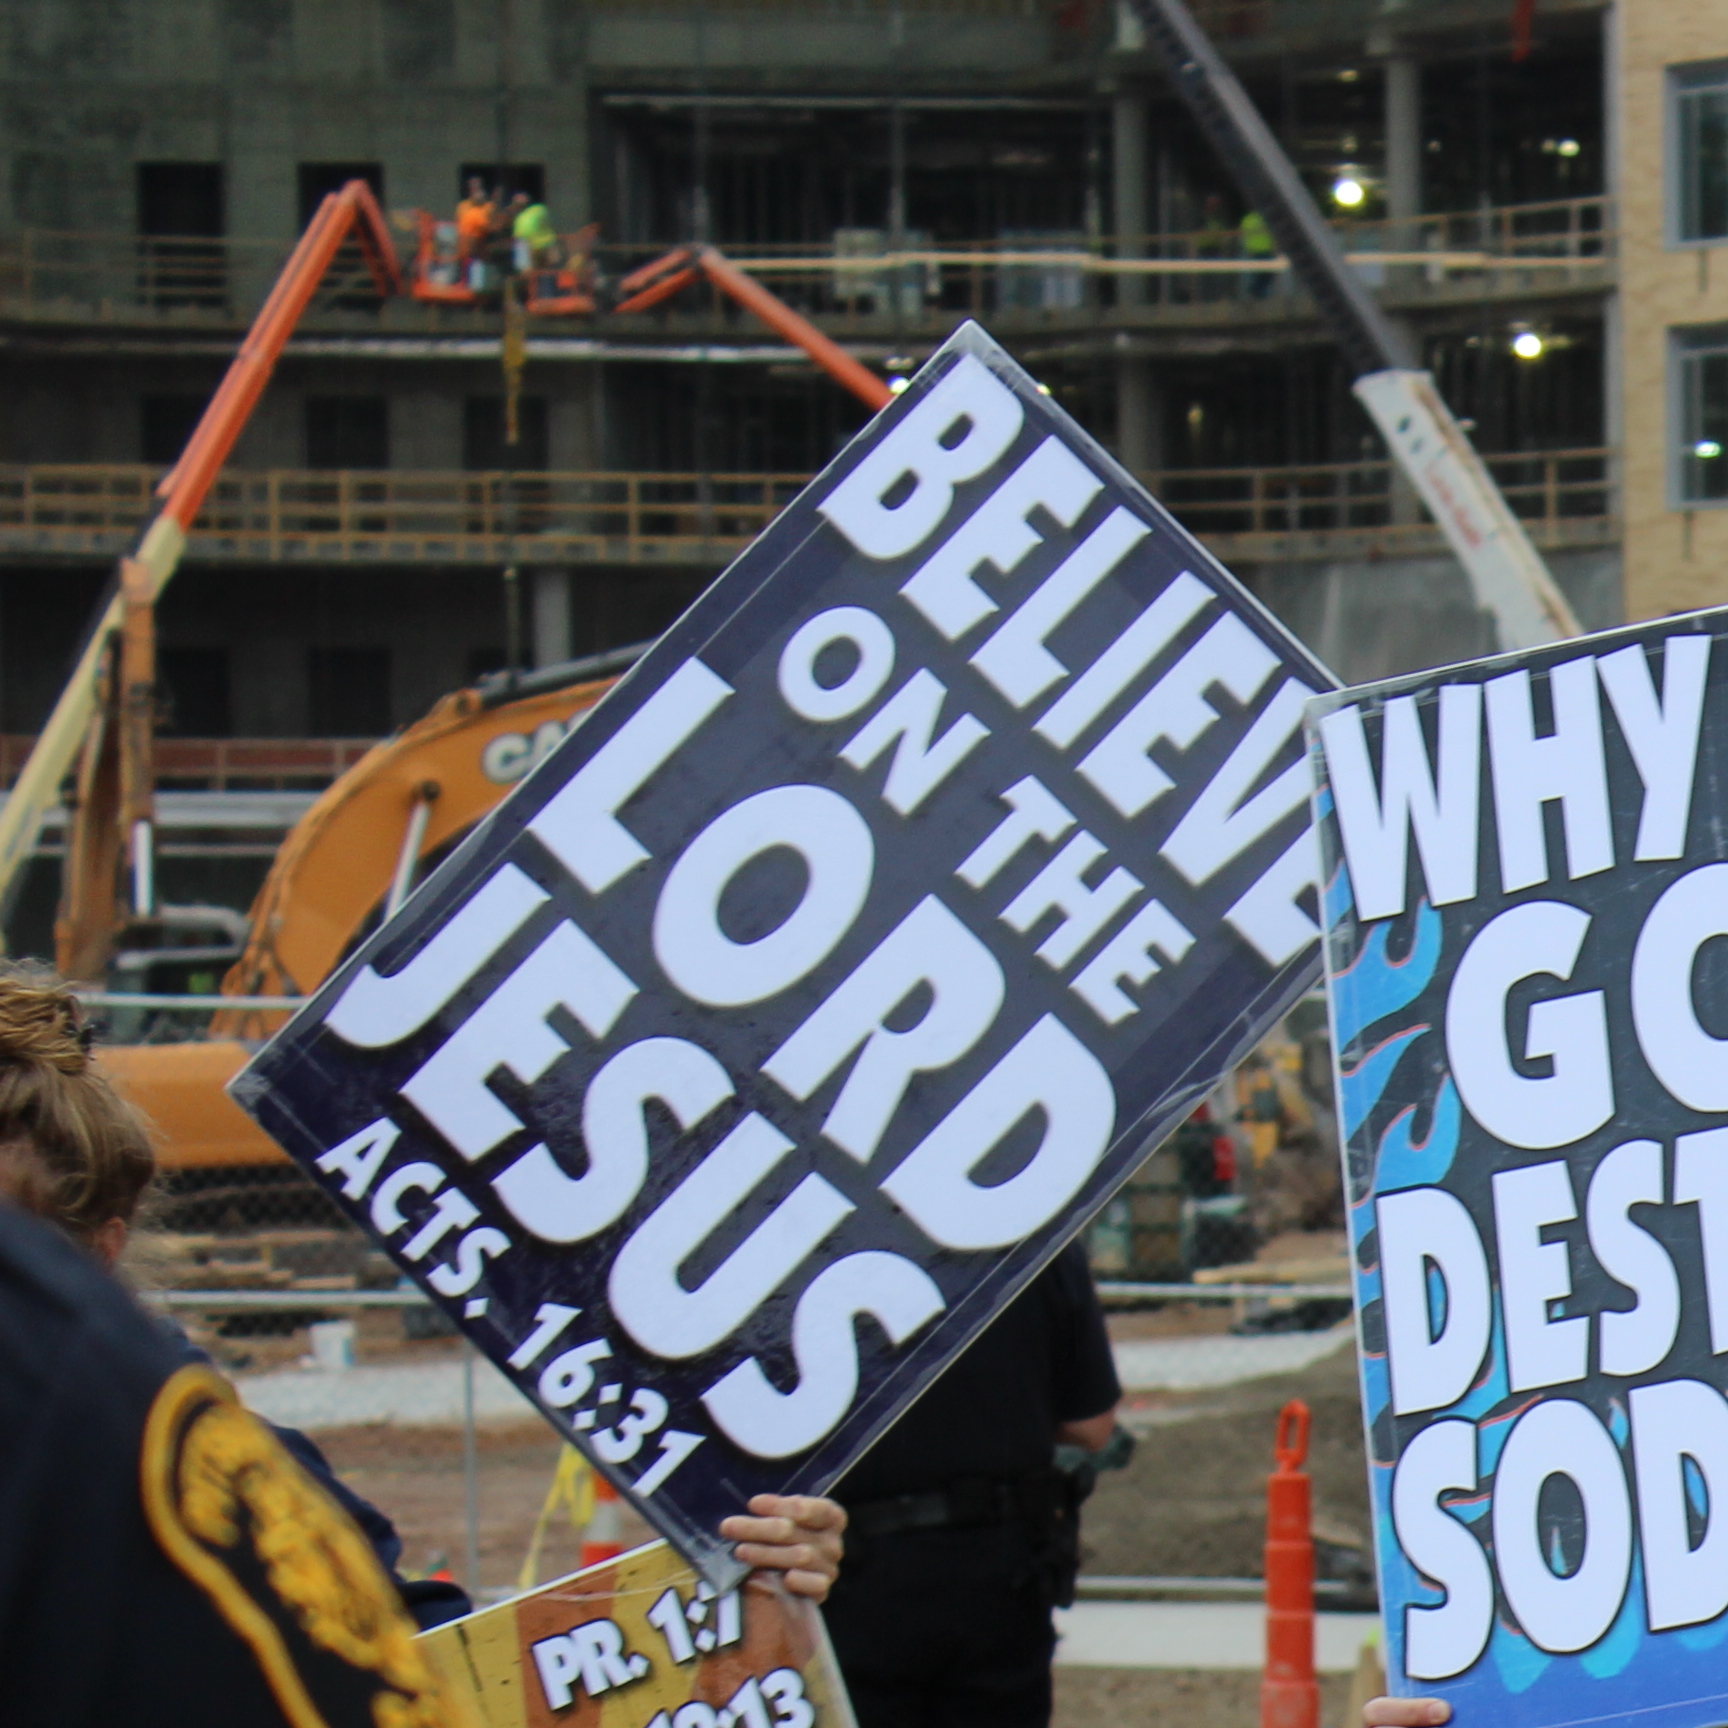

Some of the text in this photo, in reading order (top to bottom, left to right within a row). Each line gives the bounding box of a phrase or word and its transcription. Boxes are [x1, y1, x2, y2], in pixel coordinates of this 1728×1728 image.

[778, 605, 1196, 1024] ON THE
[818, 354, 1322, 967] BELIEVE
[1320, 634, 1712, 921] WHY
[323, 862, 946, 1459] JESUS
[530, 656, 1116, 1251] LORD
[317, 1117, 511, 1317] ACTS.
[508, 1302, 706, 1498] 16:31
[532, 1581, 741, 1711] PR. 1:7
